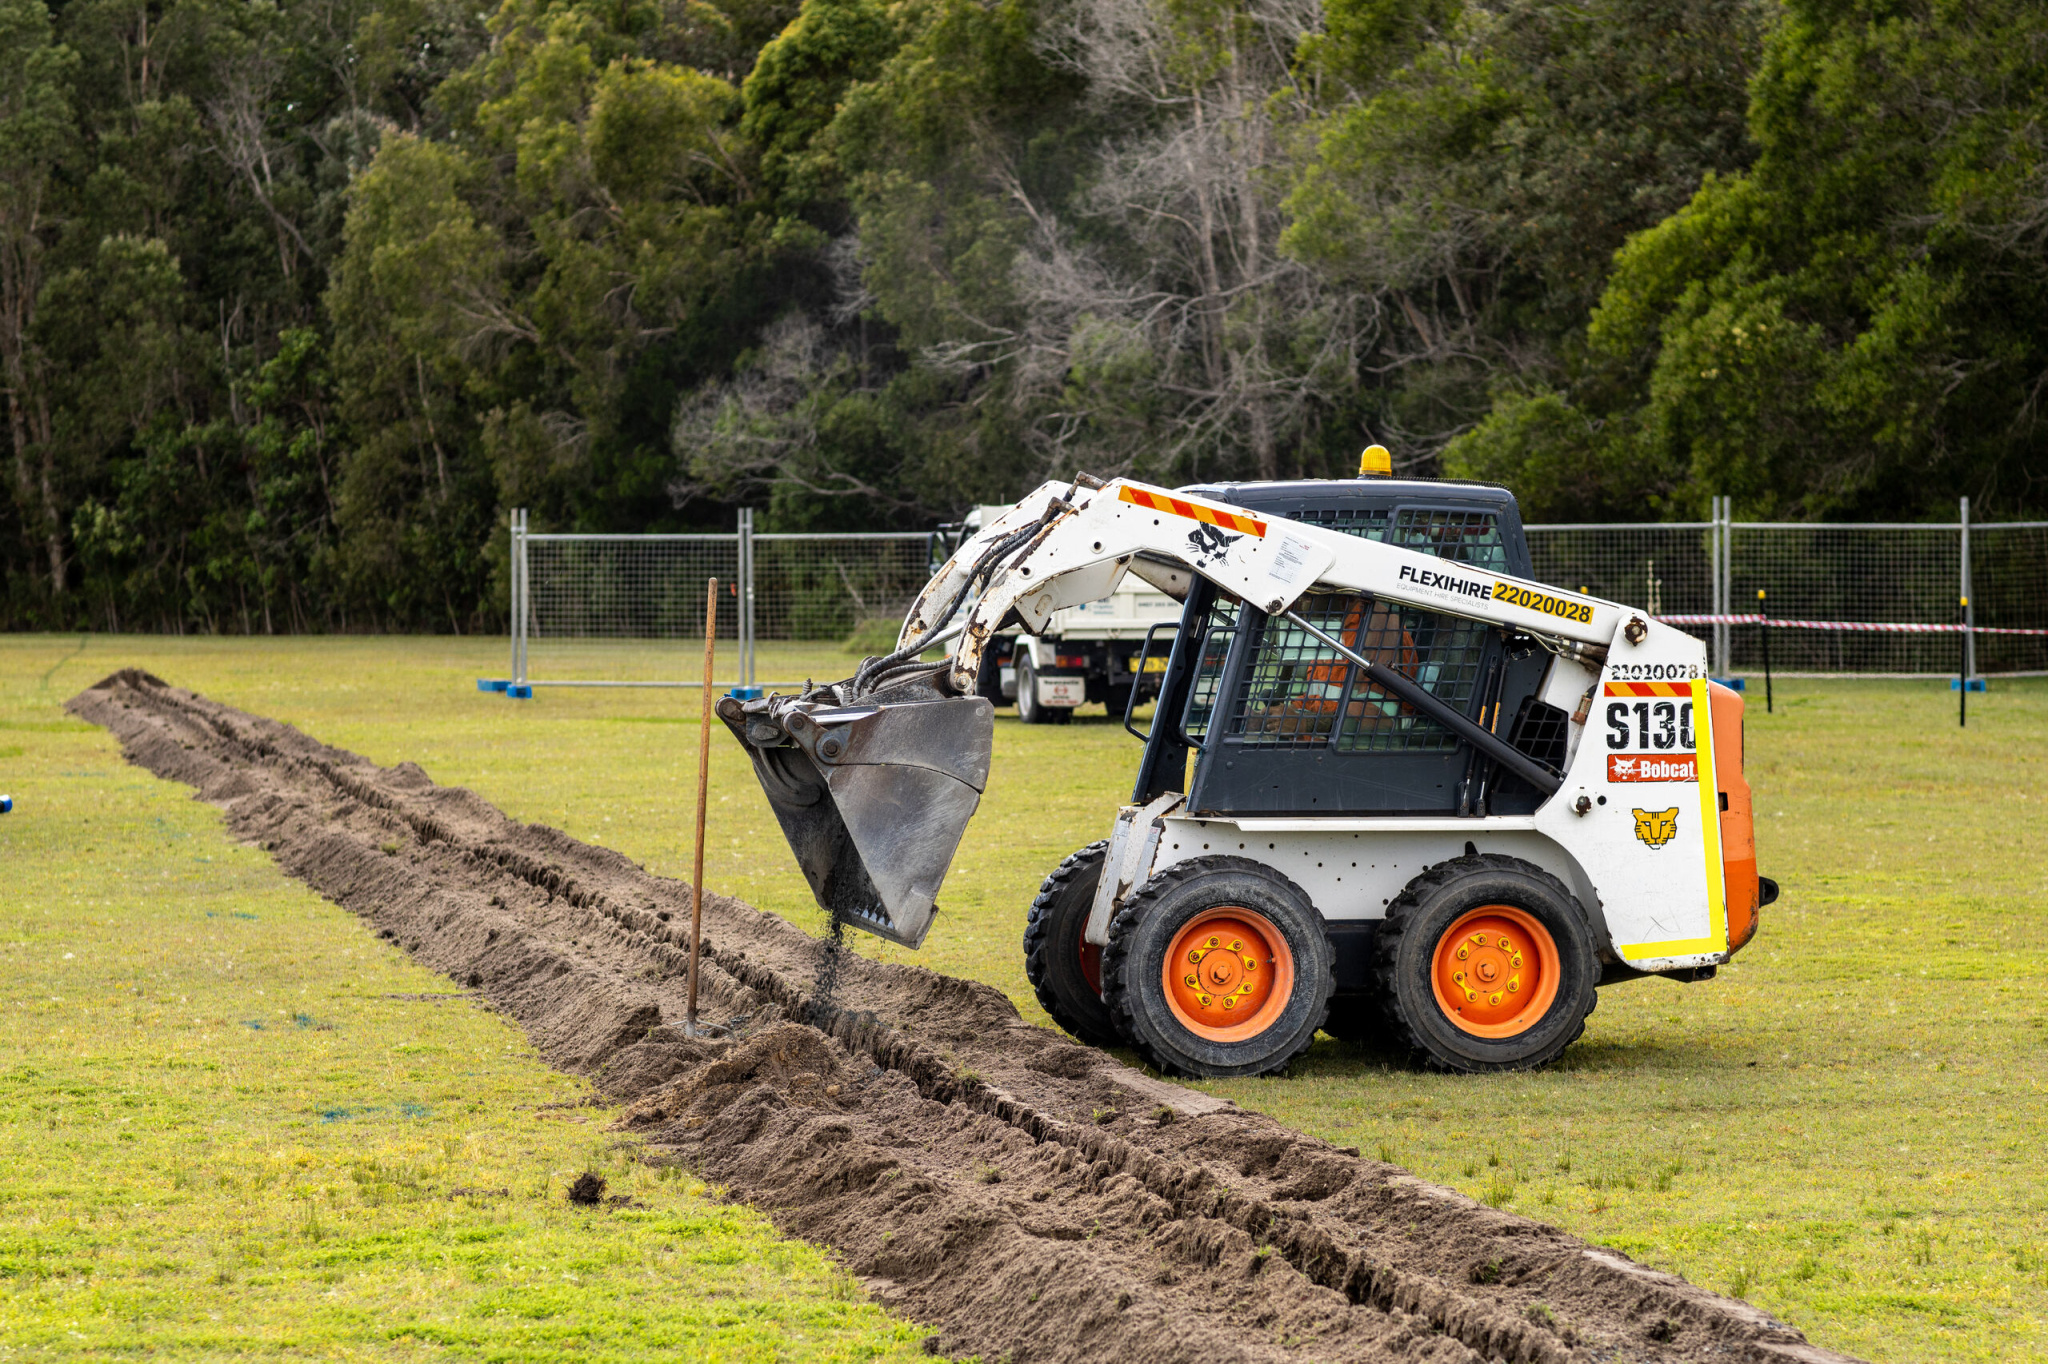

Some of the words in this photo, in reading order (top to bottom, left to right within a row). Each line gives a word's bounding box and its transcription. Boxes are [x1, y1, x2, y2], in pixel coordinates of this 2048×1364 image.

[1396, 583, 1433, 597] EQUIPMENT
[1434, 592, 1449, 600] HIRE
[1450, 595, 1489, 610] SPECIALISTS
[1399, 565, 1492, 600] FLEXIHIRE
[1494, 583, 1592, 623] 22020028
[1640, 760, 1695, 778] Bobcat
